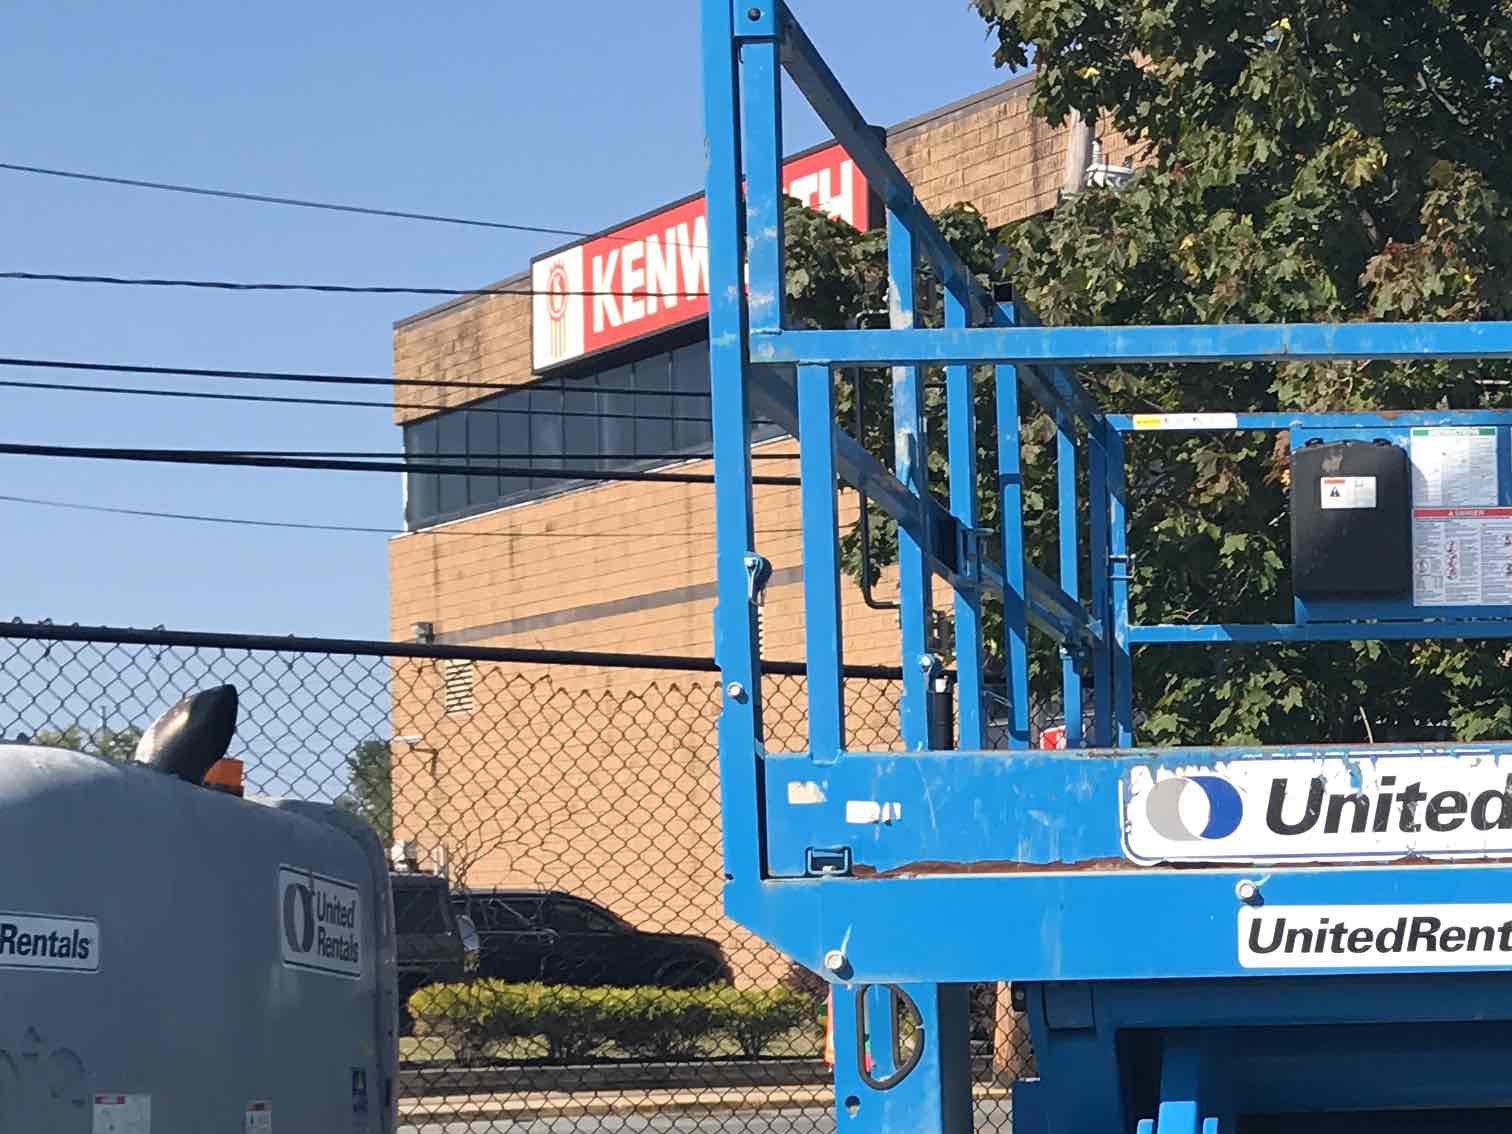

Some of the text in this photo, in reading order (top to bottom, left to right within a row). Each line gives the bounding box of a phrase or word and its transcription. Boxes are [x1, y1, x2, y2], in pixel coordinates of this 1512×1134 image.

[591, 159, 853, 333] KENWTH
[316, 890, 356, 929] United
[0, 923, 90, 959] Rentals
[317, 925, 360, 964] Rentals
